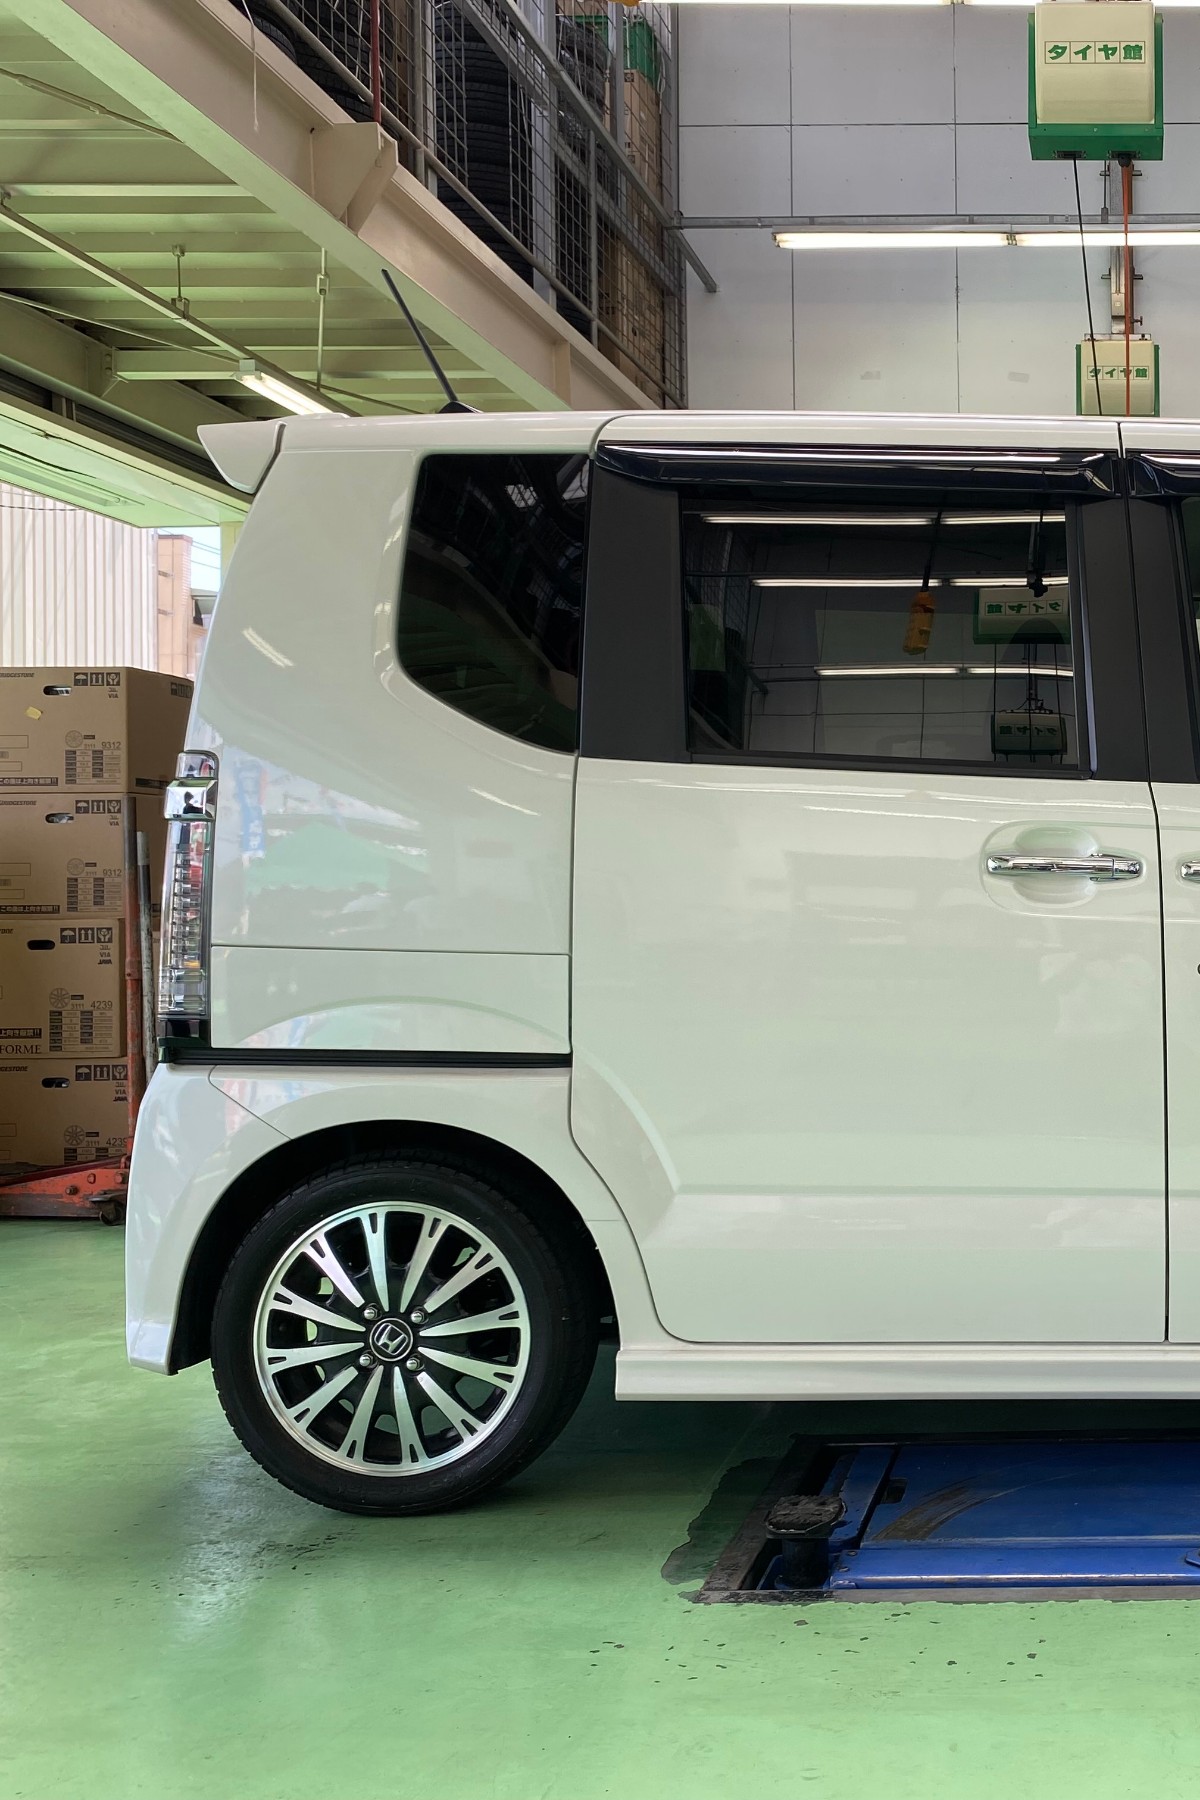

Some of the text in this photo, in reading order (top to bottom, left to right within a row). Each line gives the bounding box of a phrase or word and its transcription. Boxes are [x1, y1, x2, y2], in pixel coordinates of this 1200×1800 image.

[1047, 44, 1143, 61] タイヤ館
[101, 741, 121, 750] 9312
[102, 868, 122, 877] 9312
[91, 1000, 113, 1009] 4239
[0, 1044, 41, 1055] FORME
